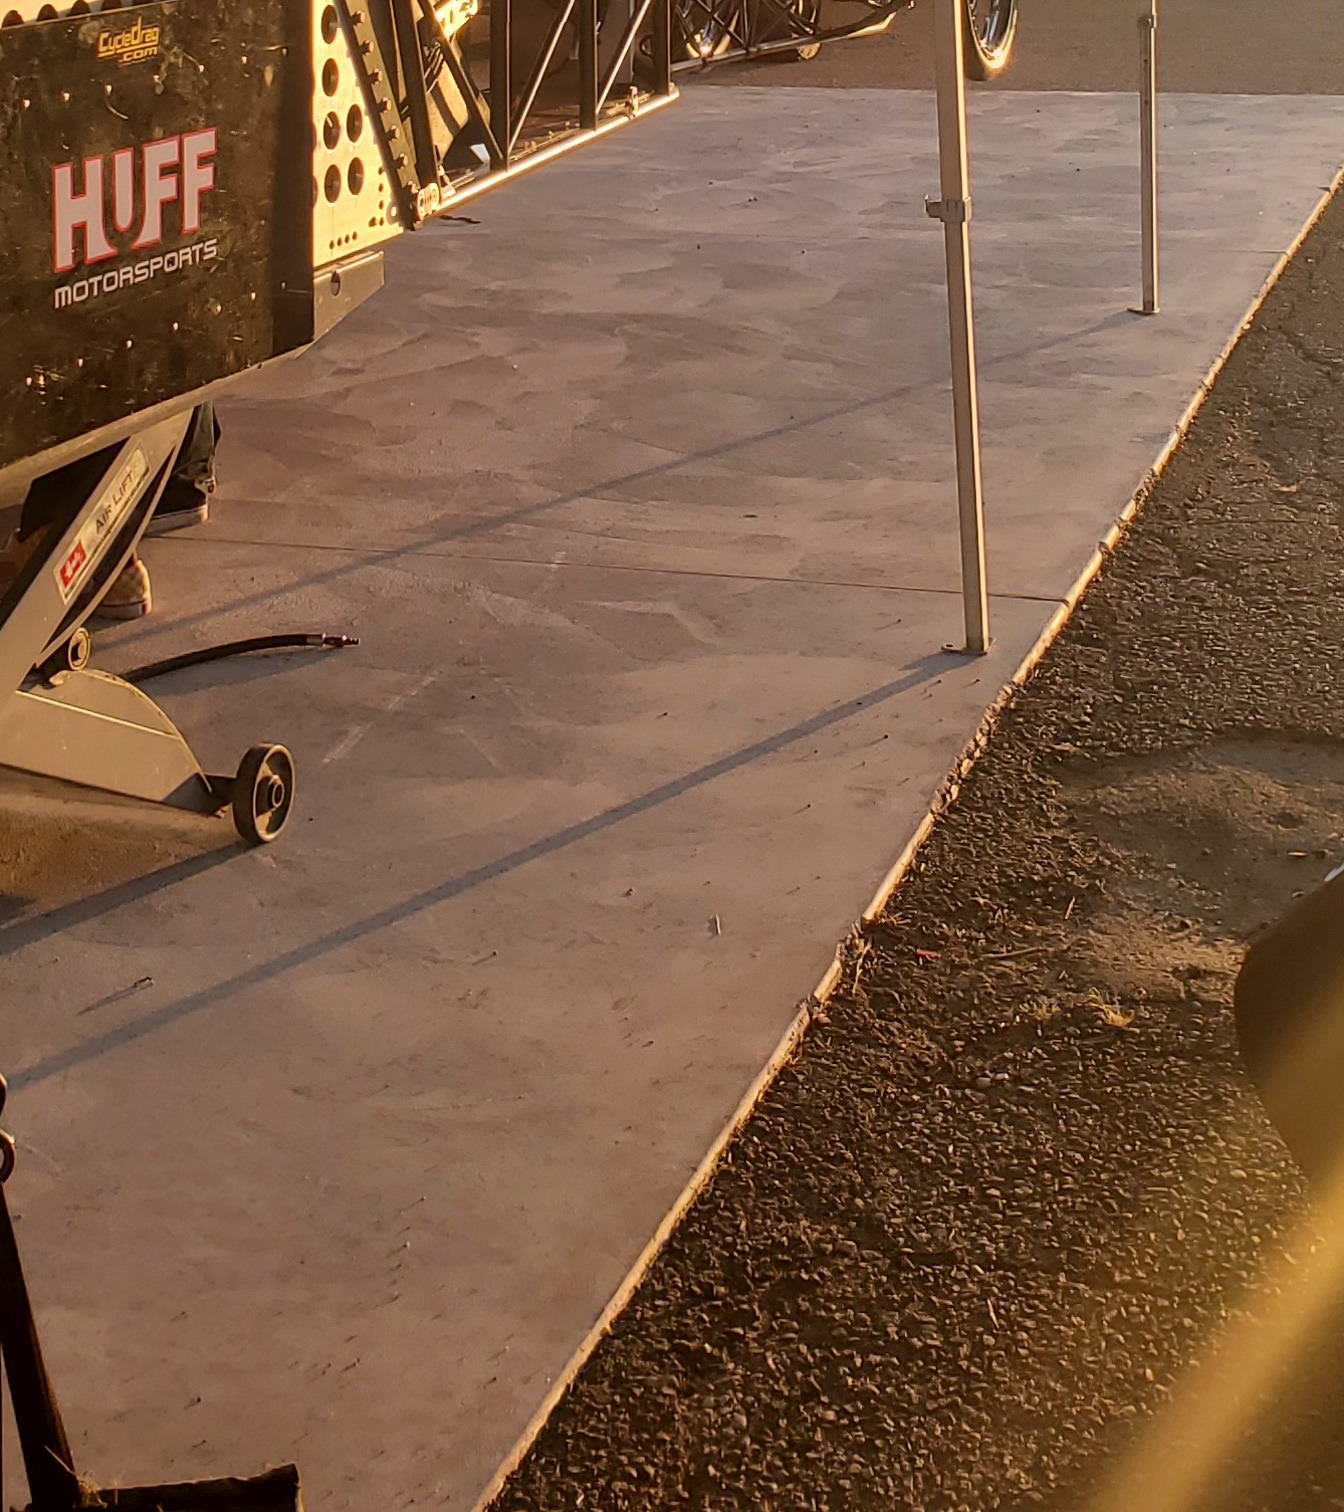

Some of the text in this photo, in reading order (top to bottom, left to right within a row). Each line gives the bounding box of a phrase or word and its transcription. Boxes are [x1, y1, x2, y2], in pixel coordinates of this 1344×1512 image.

[51, 126, 217, 273] HUFF
[54, 238, 218, 309] MOTORSPORTS
[95, 469, 136, 535] AIR LIFT
